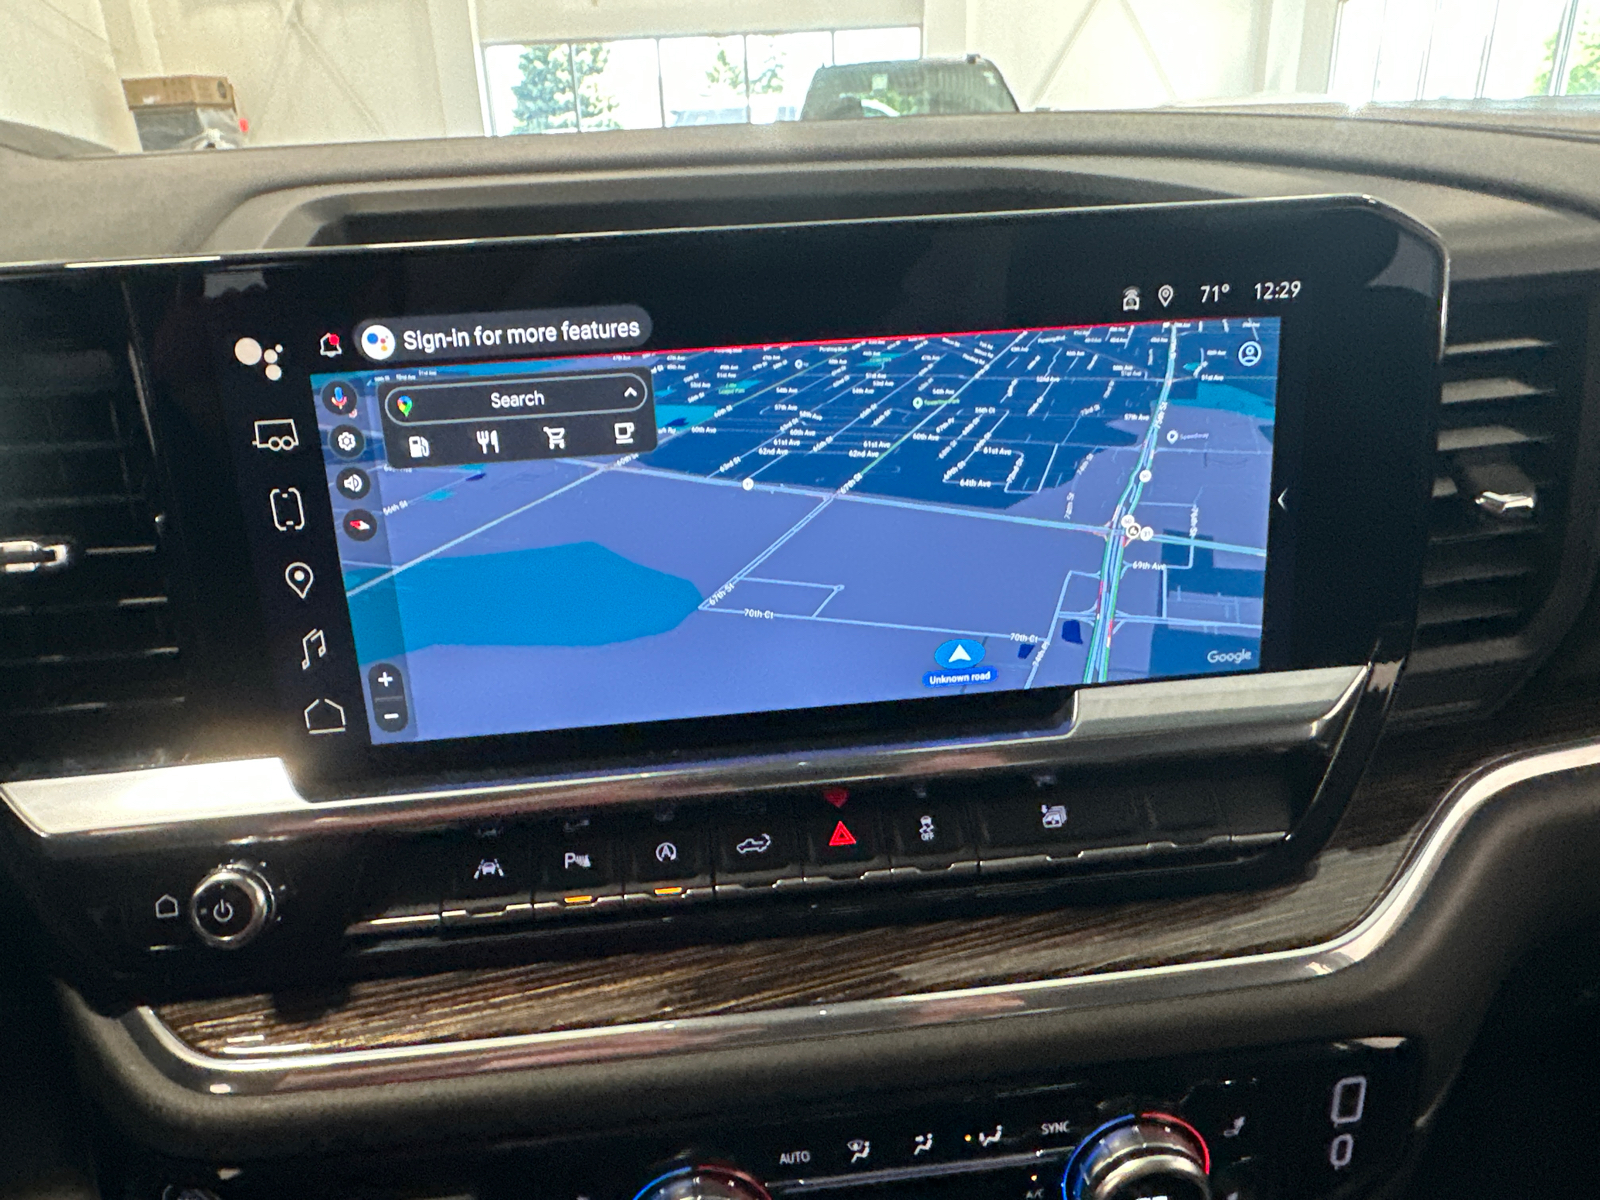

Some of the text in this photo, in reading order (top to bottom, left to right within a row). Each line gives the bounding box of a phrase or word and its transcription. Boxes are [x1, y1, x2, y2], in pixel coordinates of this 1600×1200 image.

[1200, 283, 1230, 303] 71°
[1254, 280, 1301, 300] 12:29
[403, 320, 641, 353] Sign-in for more features
[490, 389, 545, 409] Search
[725, 404, 733, 412] St
[791, 417, 799, 425] St
[811, 413, 823, 422] Ave
[1138, 413, 1150, 421] Ave
[790, 428, 816, 437] 60th Ave
[927, 433, 940, 441] Ave
[983, 431, 992, 441] St
[773, 438, 801, 446] 61st Ave
[825, 435, 834, 444] St
[863, 440, 891, 448] 61st Ave
[949, 439, 957, 448] St
[758, 447, 789, 456] 62nd Ave
[848, 449, 879, 458] 62nd Ave
[983, 446, 1012, 456] 61st Ave
[733, 455, 741, 465] St
[957, 460, 966, 470] St
[1015, 457, 1024, 467] St
[853, 472, 862, 482] St
[960, 478, 992, 488] 64th Ave
[1132, 561, 1166, 571] 69th Ave
[709, 582, 735, 606] 67th St
[744, 608, 762, 618] 70th
[1010, 632, 1028, 643] 70th
[1207, 648, 1252, 664] Google
[929, 670, 991, 685] Unknown road
[1041, 1120, 1070, 1136] SYNC
[779, 1150, 811, 1166] AUTO
